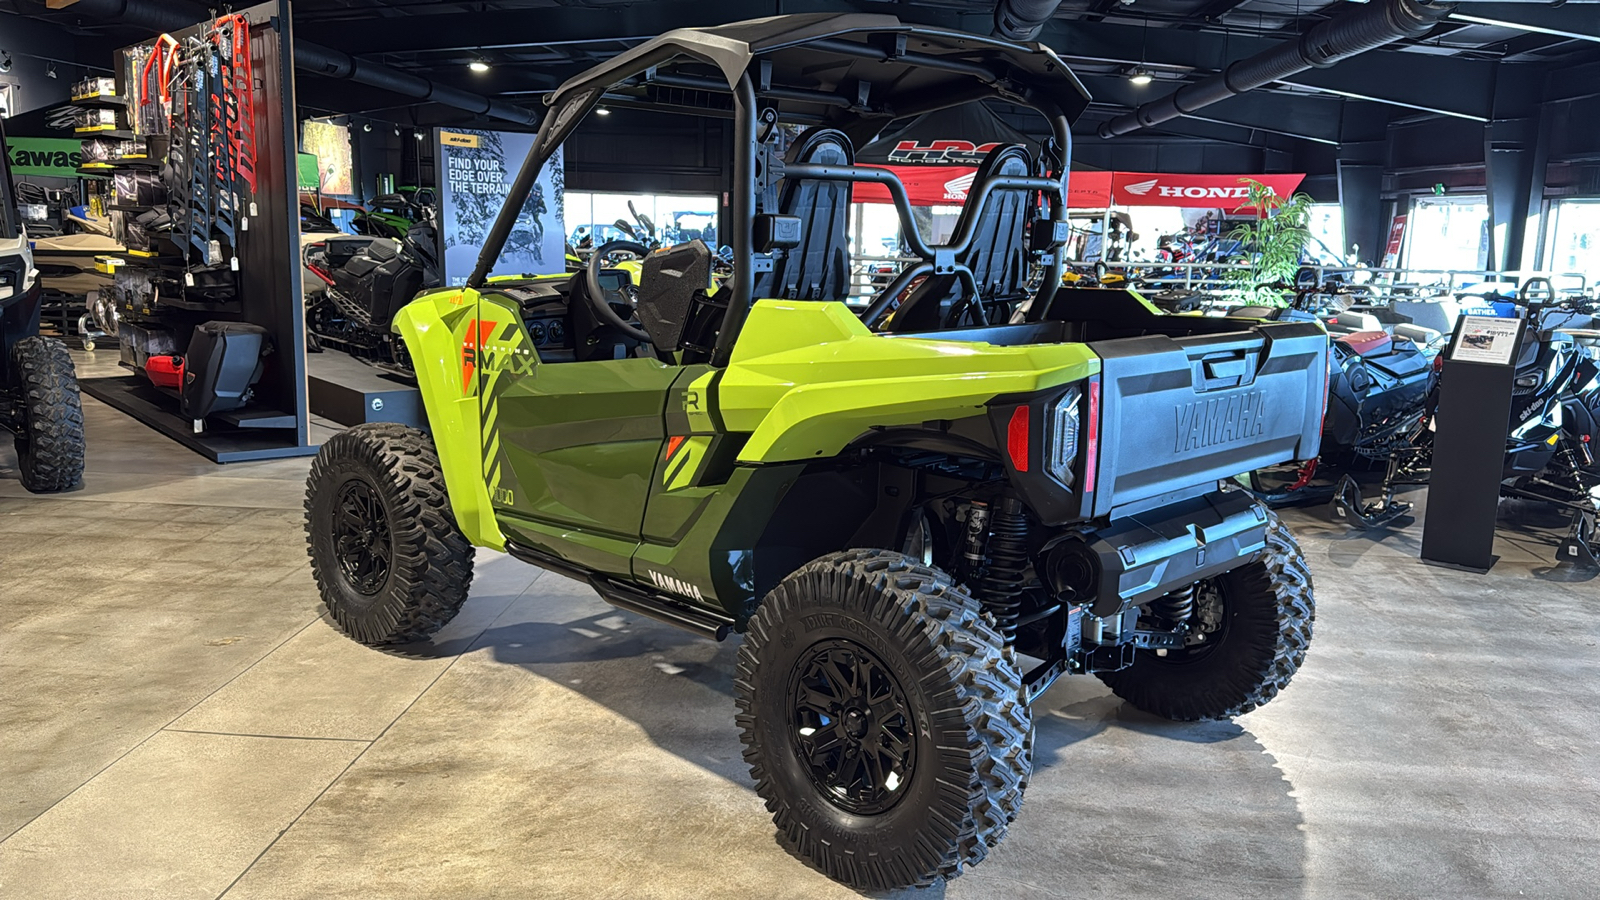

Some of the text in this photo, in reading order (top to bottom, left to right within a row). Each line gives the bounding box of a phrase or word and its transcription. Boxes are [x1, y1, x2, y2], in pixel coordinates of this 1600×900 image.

[7, 145, 81, 168] Kawas
[448, 156, 500, 172] FIND YOUR
[448, 168, 503, 184] EDGE OVER
[448, 180, 512, 195] THE TERRAIN
[463, 348, 535, 376] RMAX
[1174, 390, 1267, 453] YAMAHA
[648, 569, 704, 602] YAMAHA
[805, 614, 834, 629] DIRT
